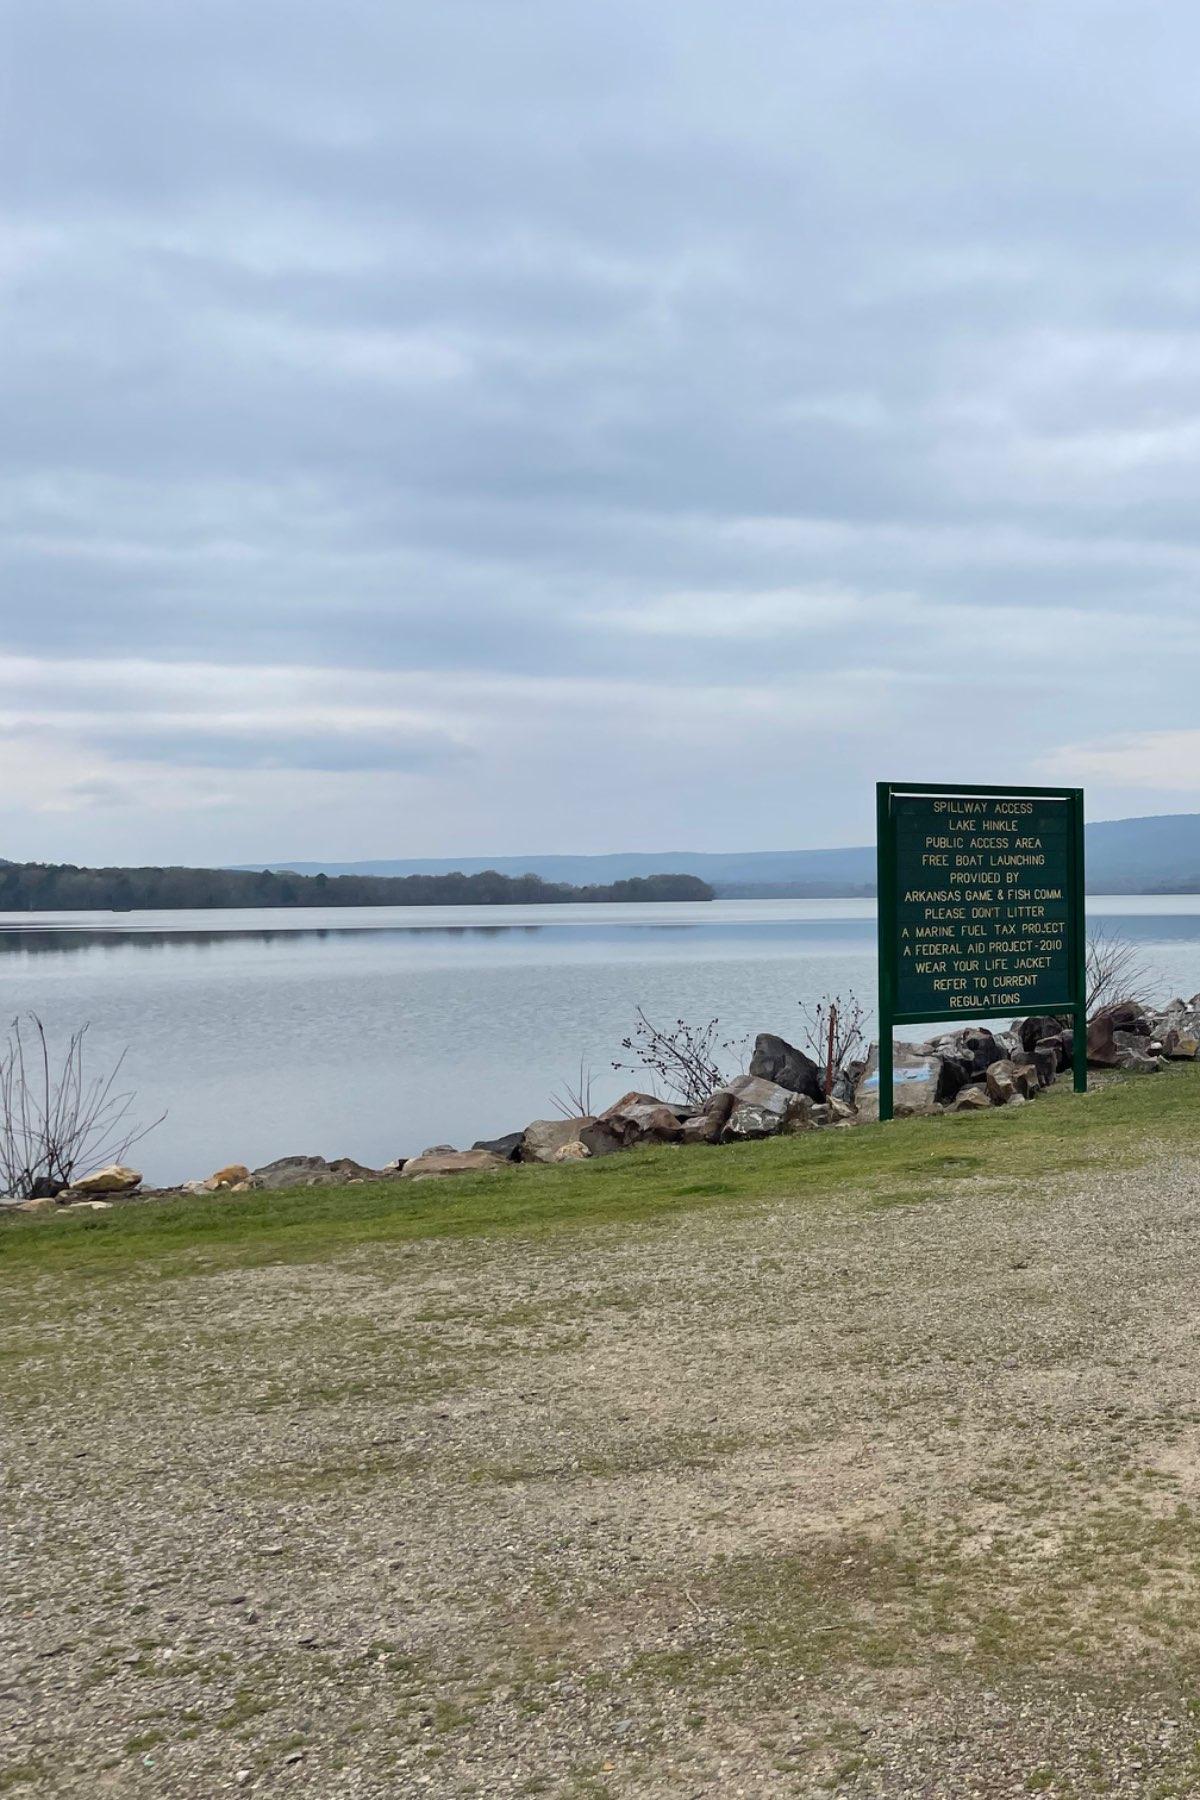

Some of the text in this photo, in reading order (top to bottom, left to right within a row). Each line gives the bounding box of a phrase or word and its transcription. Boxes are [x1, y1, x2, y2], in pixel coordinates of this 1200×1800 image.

[933, 802, 1033, 814] SPILLWAY ACCESS
[949, 820, 1018, 832] LAKE HINKLE
[925, 837, 1042, 848] PUBLIC ACCESS AREA
[922, 855, 1045, 866] FREE BOAT LAUNCHING
[950, 872, 1019, 883] PROVIDED BY
[905, 891, 961, 902] ARKANSAS
[966, 890, 994, 900] GAME
[998, 890, 1004, 900] &
[1008, 889, 1031, 899] FISH
[925, 908, 965, 919] PLEASE
[1007, 907, 1045, 917] LITTER
[901, 922, 1065, 937] A MARINE FUEL TAX PROJECT
[903, 946, 911, 955] A
[916, 944, 962, 955] FEDERAL
[967, 943, 985, 953] AID
[916, 957, 1051, 973] WEAR YOUR LIFE JACKET
[934, 975, 1037, 990] REFER TO CURRENT
[949, 993, 1020, 1007] REGULATIONS
